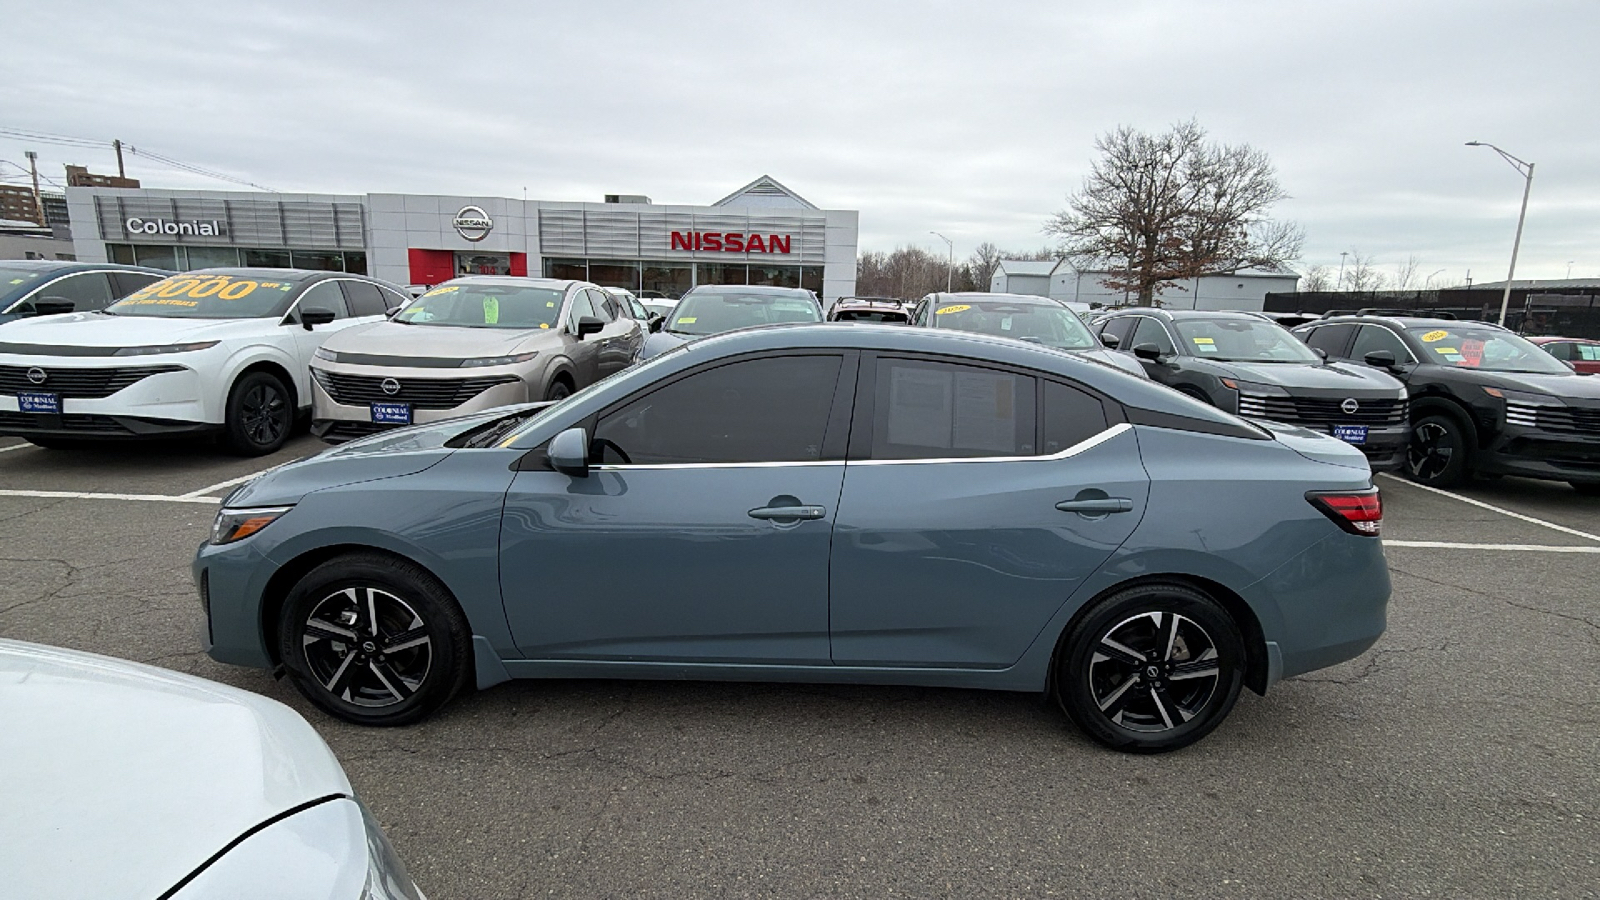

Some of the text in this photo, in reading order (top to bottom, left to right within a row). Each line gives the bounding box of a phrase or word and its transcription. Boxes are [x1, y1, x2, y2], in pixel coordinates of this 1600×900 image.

[126, 217, 219, 236] Colonial
[456, 219, 489, 227] NISSAN
[671, 231, 791, 254] NISSAN
